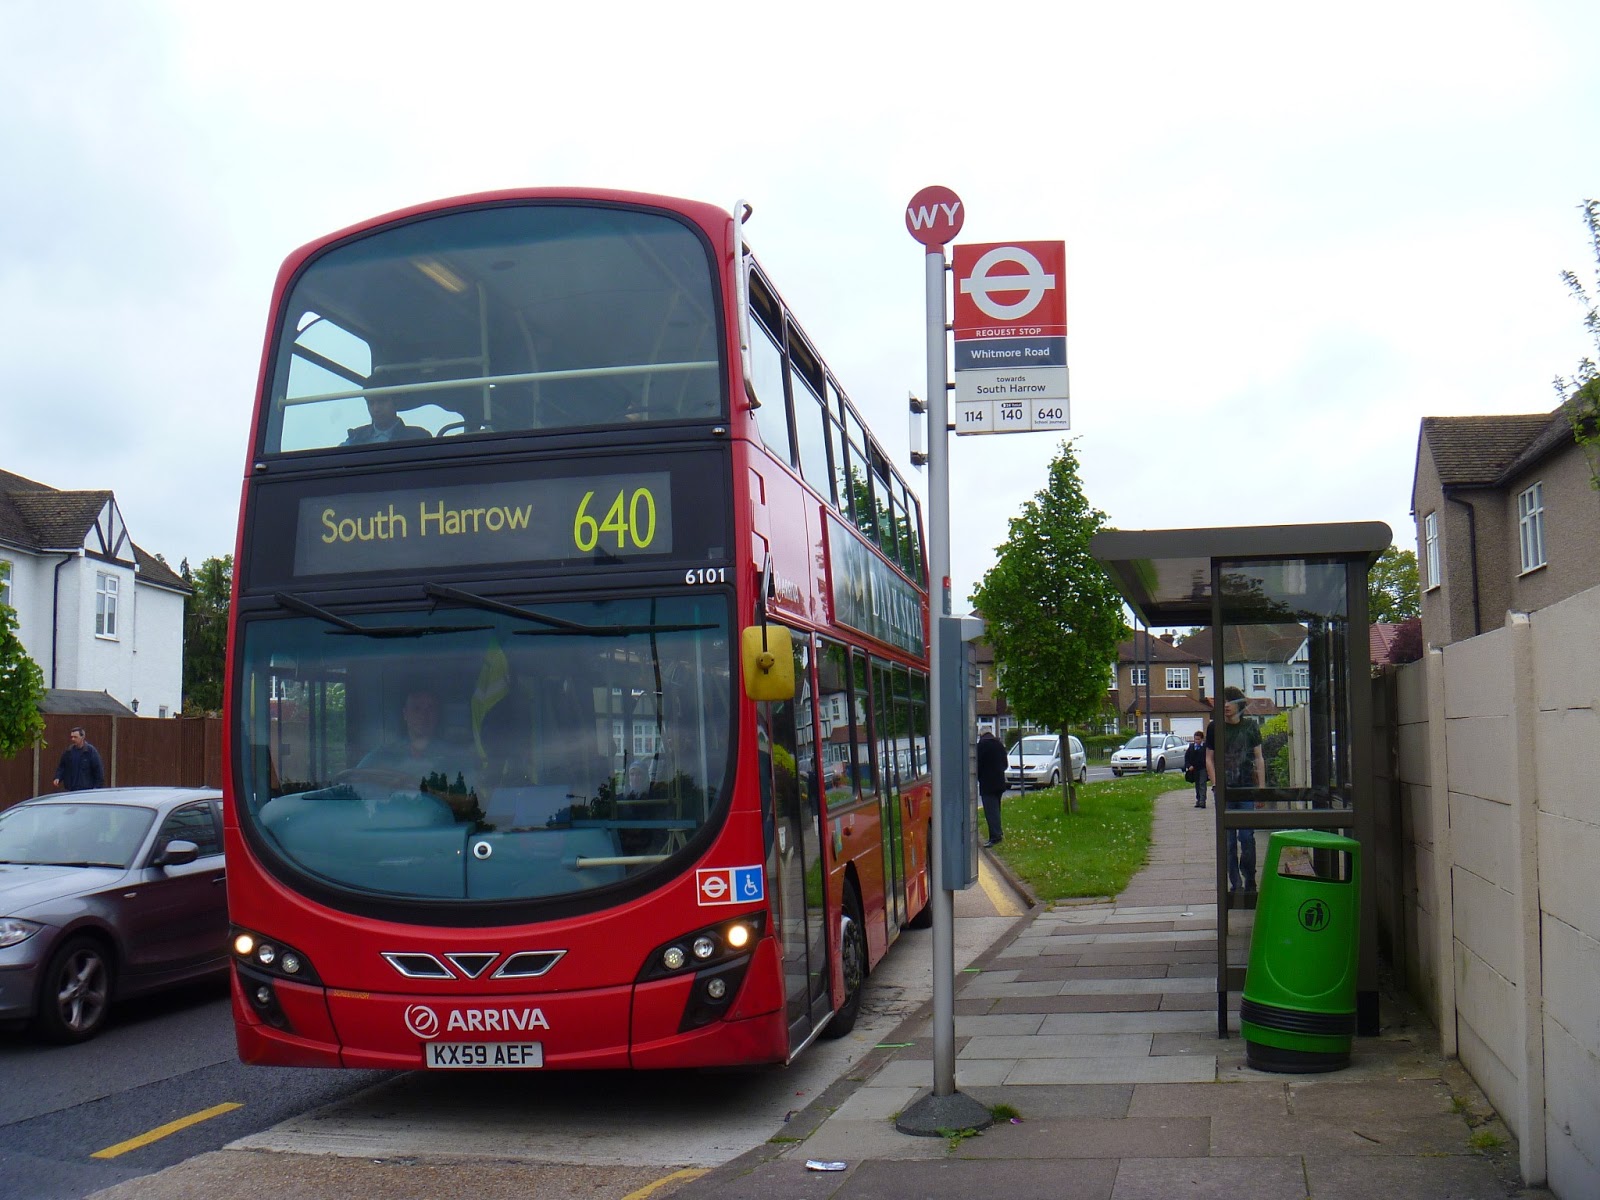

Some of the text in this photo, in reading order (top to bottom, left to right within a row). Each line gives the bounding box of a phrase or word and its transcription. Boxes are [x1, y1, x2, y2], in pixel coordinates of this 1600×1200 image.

[908, 202, 960, 230] WY
[976, 328, 1016, 337] REQUEST
[971, 347, 1050, 359] Whitmore Road
[977, 384, 1046, 394] South Harrow
[965, 411, 983, 422] 114
[1001, 409, 1022, 420] 140
[1038, 408, 1063, 419] 640
[321, 500, 533, 544] South Harrow
[574, 487, 656, 552] 640
[685, 567, 725, 584] 6101
[446, 1008, 550, 1031] ARRIVA
[434, 1045, 533, 1065] KX59 AEF
